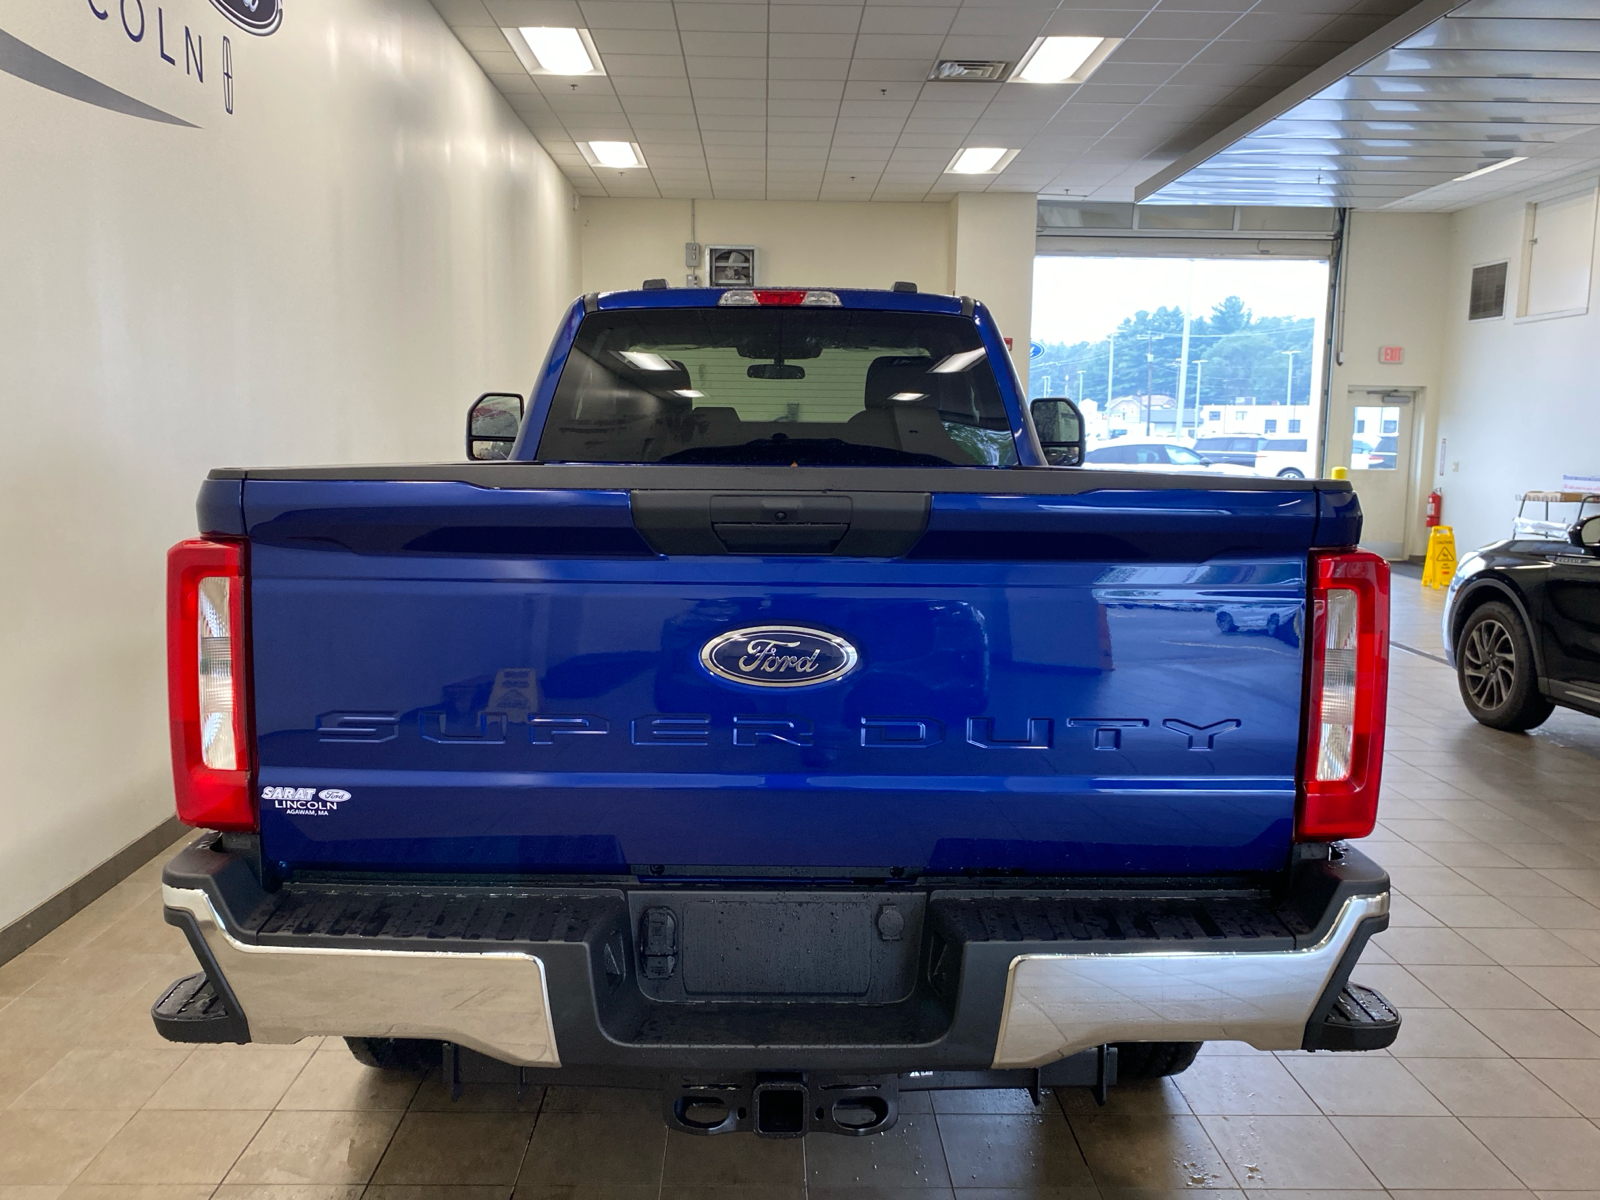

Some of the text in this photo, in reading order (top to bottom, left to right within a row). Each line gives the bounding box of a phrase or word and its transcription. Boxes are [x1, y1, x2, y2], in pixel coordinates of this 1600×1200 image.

[1383, 346, 1403, 362] EXIT
[738, 639, 821, 673] Ford
[316, 709, 1242, 751] SUPER DUTY
[261, 786, 317, 801] SARAT
[274, 800, 338, 810] LINCOLN
